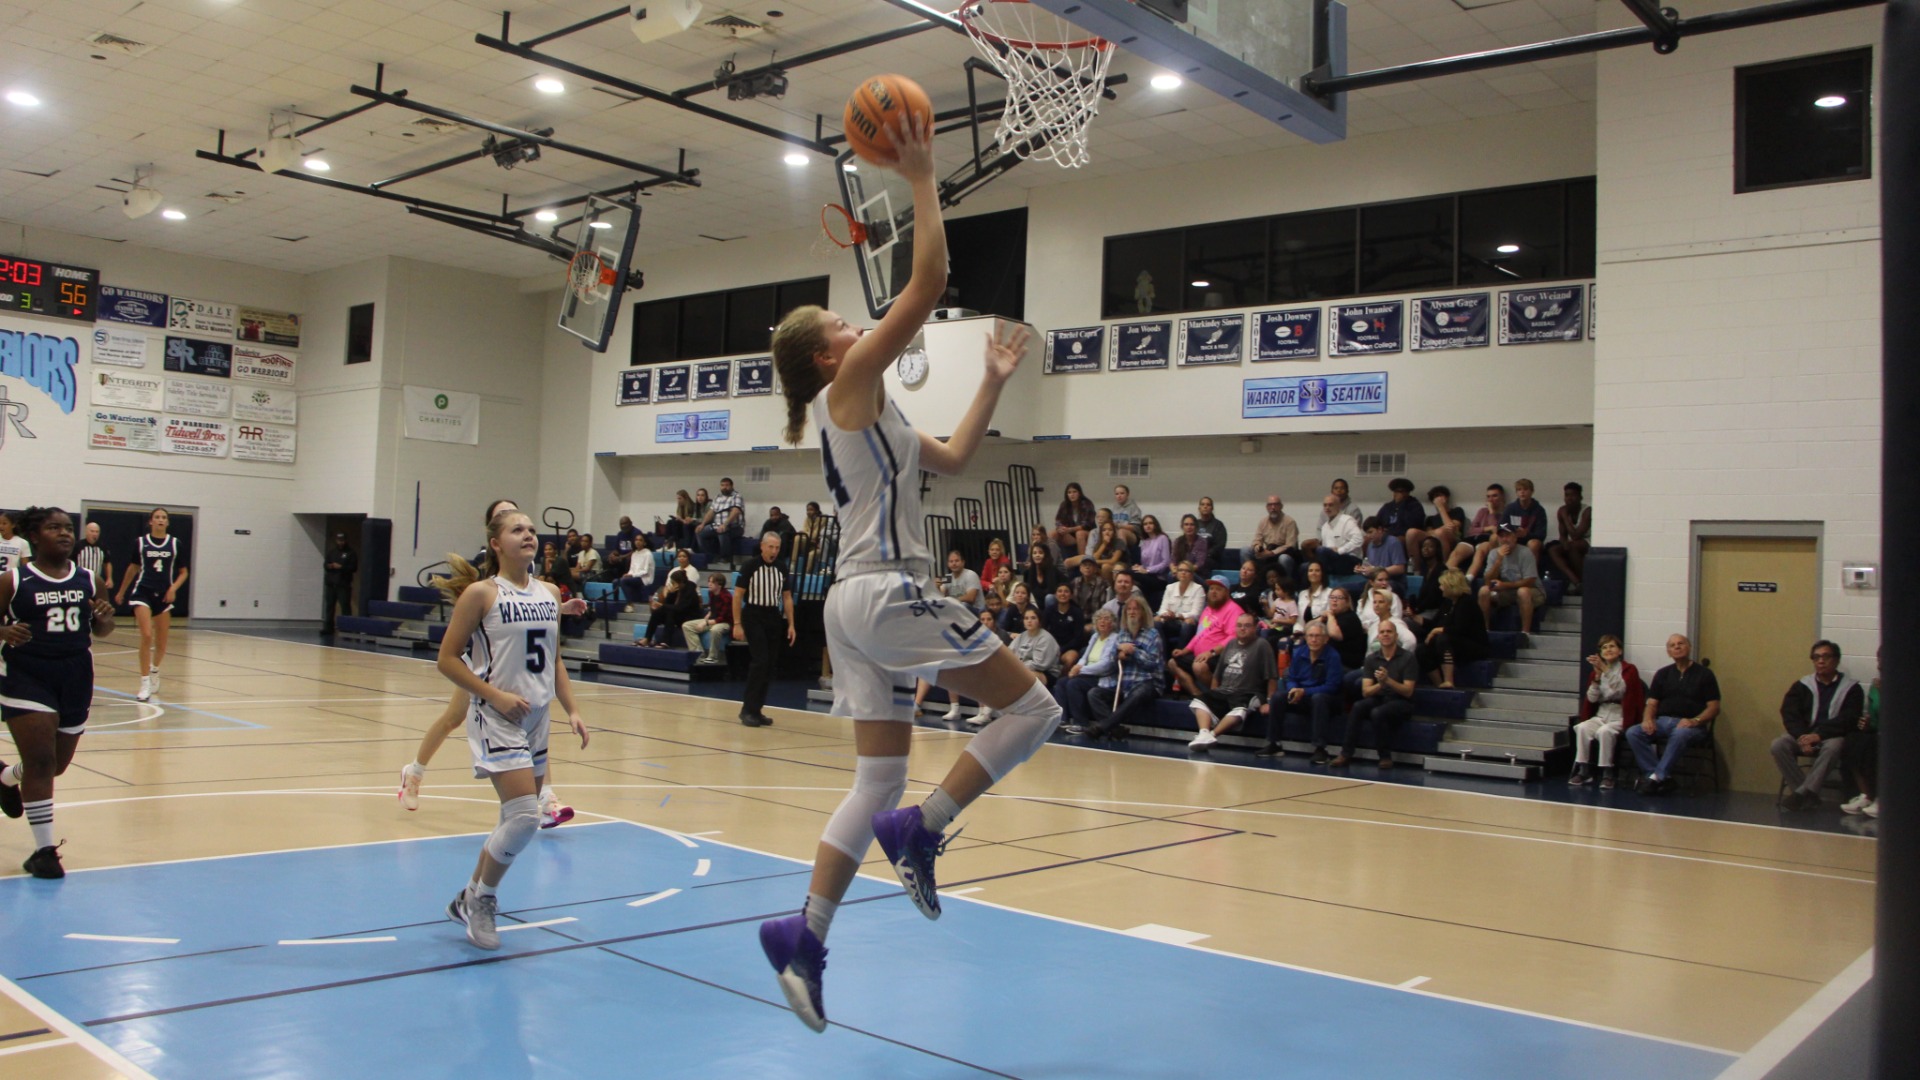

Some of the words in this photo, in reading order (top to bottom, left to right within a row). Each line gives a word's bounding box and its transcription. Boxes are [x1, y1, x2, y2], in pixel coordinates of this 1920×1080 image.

[55, 267, 91, 281] HOME
[20, 292, 31, 309] 3
[60, 282, 87, 306] 56
[101, 286, 115, 296] GO
[116, 288, 164, 304] WARRIORS
[1516, 293, 1537, 305] Cory
[1539, 290, 1572, 302] Weiand
[1457, 298, 1479, 309] Gage
[1266, 313, 1283, 323] Josh
[1284, 311, 1312, 323] Downey
[1344, 306, 1363, 316] John
[1142, 324, 1161, 333] Woods
[1531, 320, 1556, 328] BASEBALL
[1179, 322, 1187, 360] 2010
[1374, 341, 1397, 350] College
[1294, 346, 1315, 355] College
[261, 355, 293, 367] ROOFING
[1073, 362, 1098, 370] University
[1139, 357, 1166, 366] University
[237, 365, 249, 373] GO
[251, 366, 289, 379] WARRIORS
[1246, 388, 1296, 406] WARRIOR
[1331, 384, 1382, 402] SEATING
[95, 412, 108, 420] Go
[109, 413, 146, 423] Warriors!
[165, 425, 201, 440] Tidwell
[658, 422, 683, 434] VISITOR
[700, 419, 727, 432] SEATING
[146, 550, 172, 558] BISHOP
[153, 559, 163, 572] 4
[34, 590, 85, 605] BISHOP
[46, 606, 81, 633] 20
[498, 601, 558, 624] WARRIORS
[526, 628, 547, 673] 5
